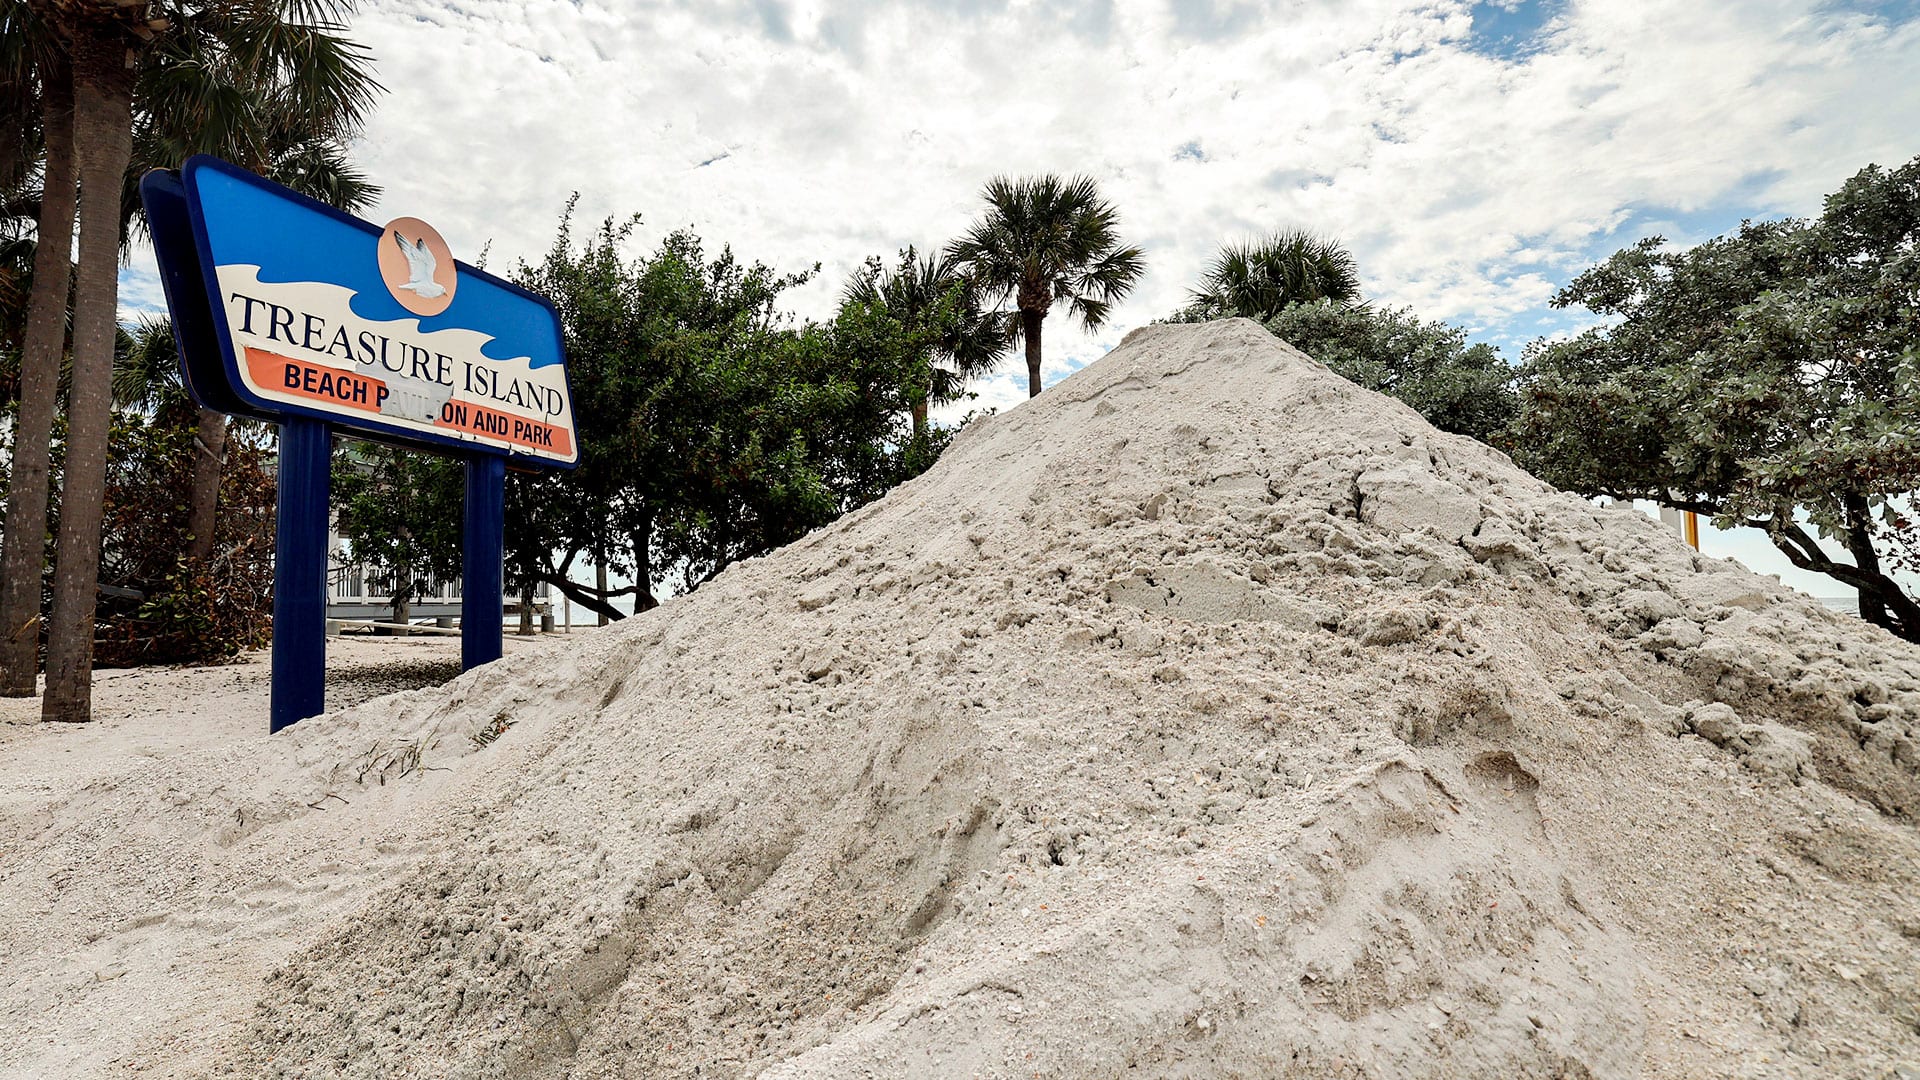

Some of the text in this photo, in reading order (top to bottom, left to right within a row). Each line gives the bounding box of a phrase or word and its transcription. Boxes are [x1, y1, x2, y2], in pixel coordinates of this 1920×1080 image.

[231, 293, 563, 416] TREASURE ISLAND
[284, 363, 367, 404] BEACH
[473, 410, 508, 438] AND
[514, 424, 553, 447] PARK
